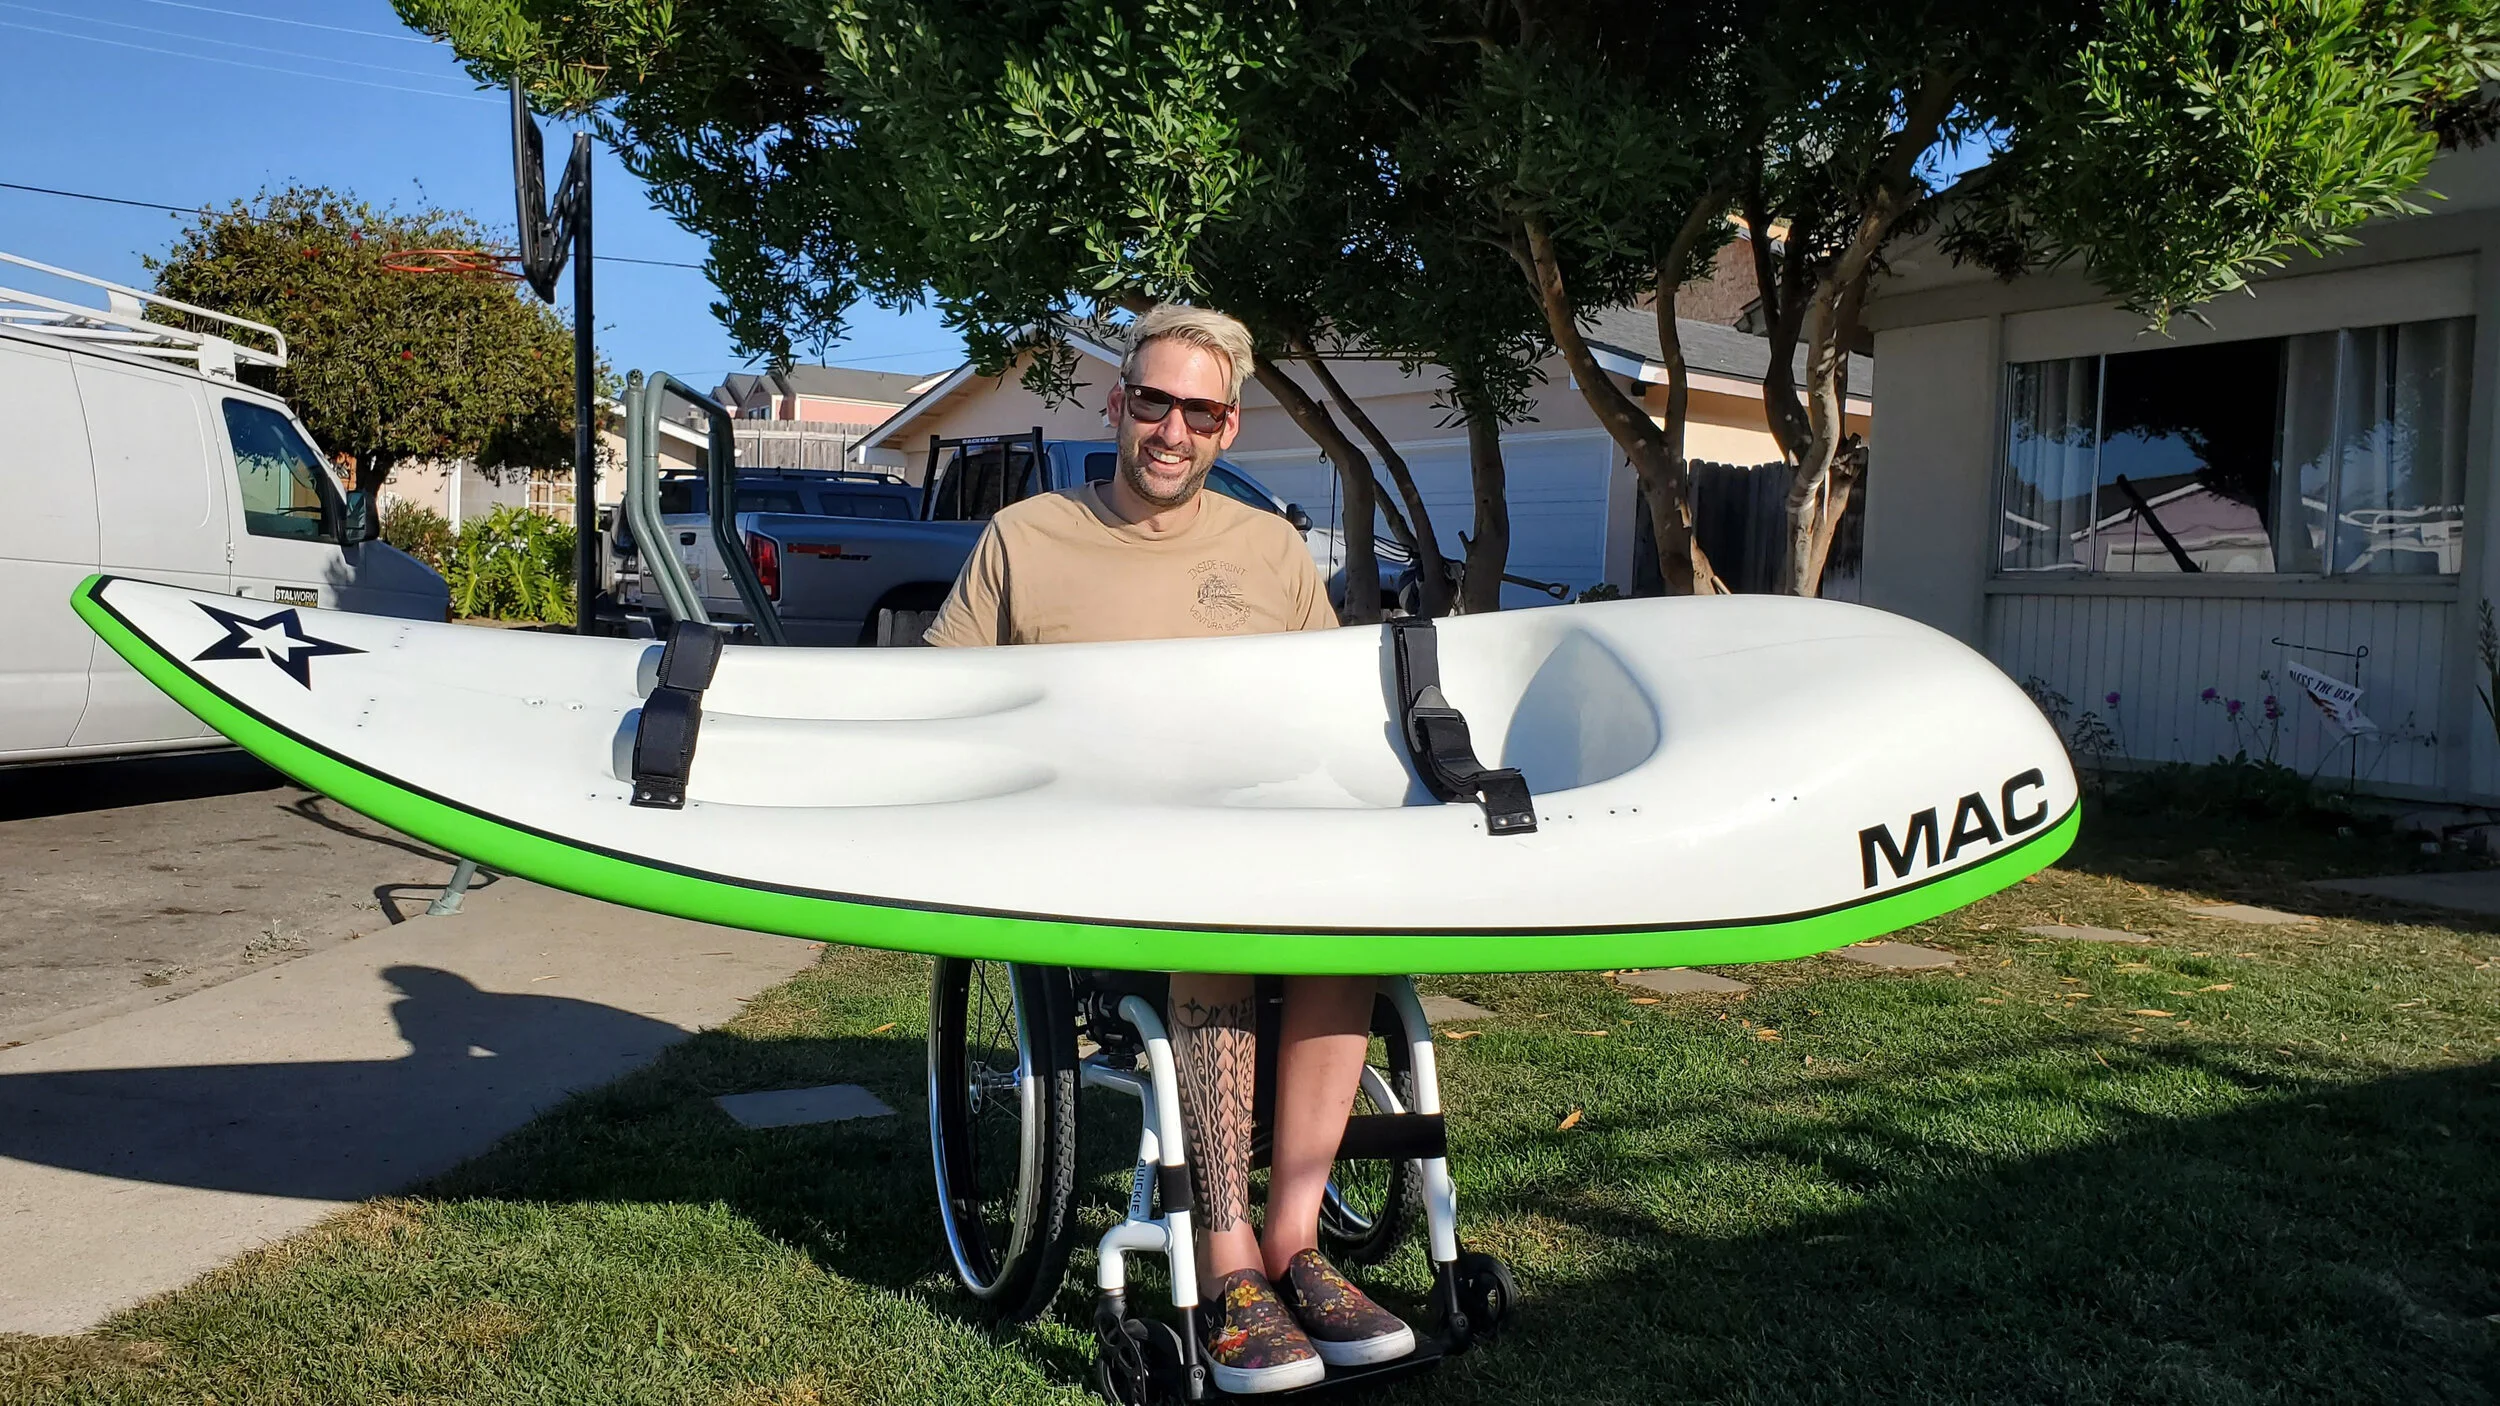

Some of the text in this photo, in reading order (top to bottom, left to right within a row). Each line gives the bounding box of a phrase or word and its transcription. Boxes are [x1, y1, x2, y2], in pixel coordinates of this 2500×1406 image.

[1187, 560, 1247, 580] INSIDE POINT
[1189, 605, 1223, 631] VENTURA
[2314, 680, 2334, 695] THE
[2334, 688, 2355, 702] USA
[1858, 767, 2049, 890] MAC
[1131, 1159, 1146, 1214] QUICKIE
